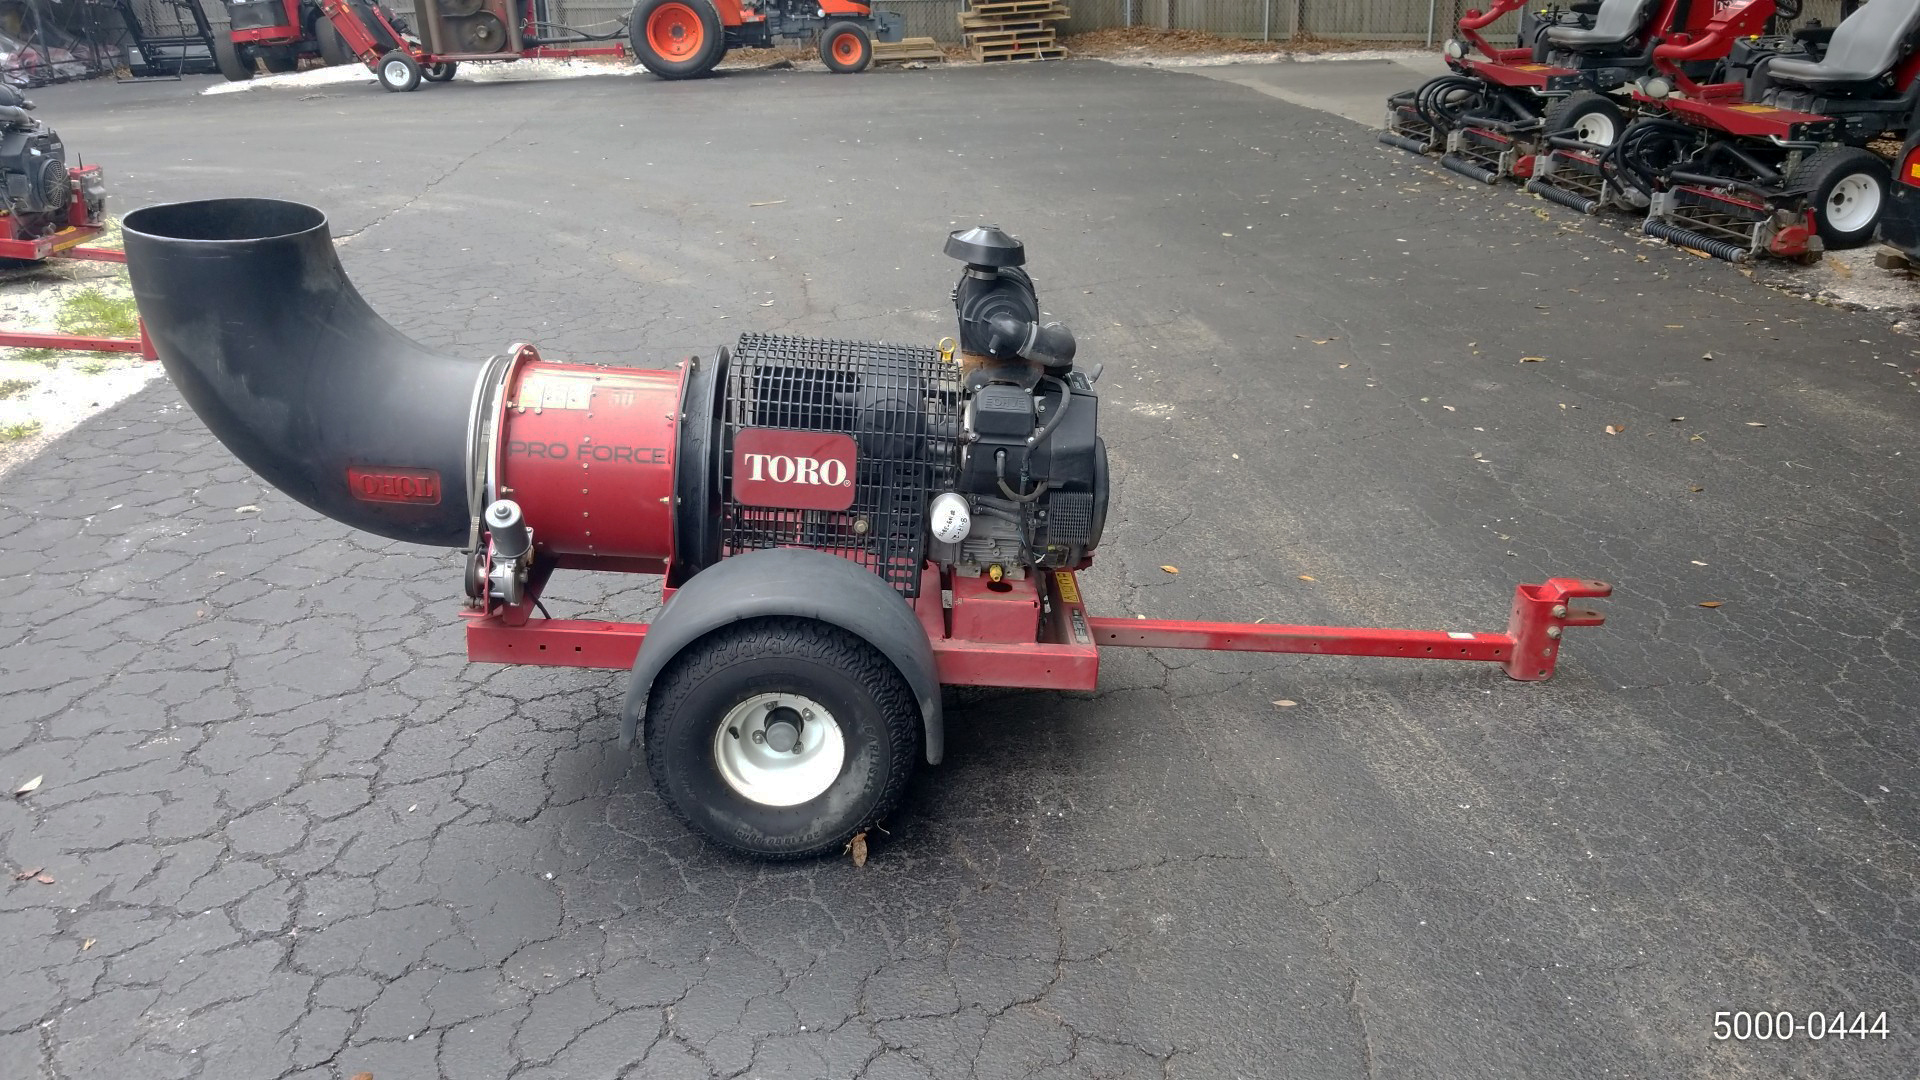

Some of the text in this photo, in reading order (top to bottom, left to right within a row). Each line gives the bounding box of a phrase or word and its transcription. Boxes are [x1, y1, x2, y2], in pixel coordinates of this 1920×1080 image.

[508, 441, 667, 465] PRO FORCE
[744, 453, 848, 487] TORO
[361, 474, 434, 497] TORO
[863, 726, 881, 793] CARLISLE
